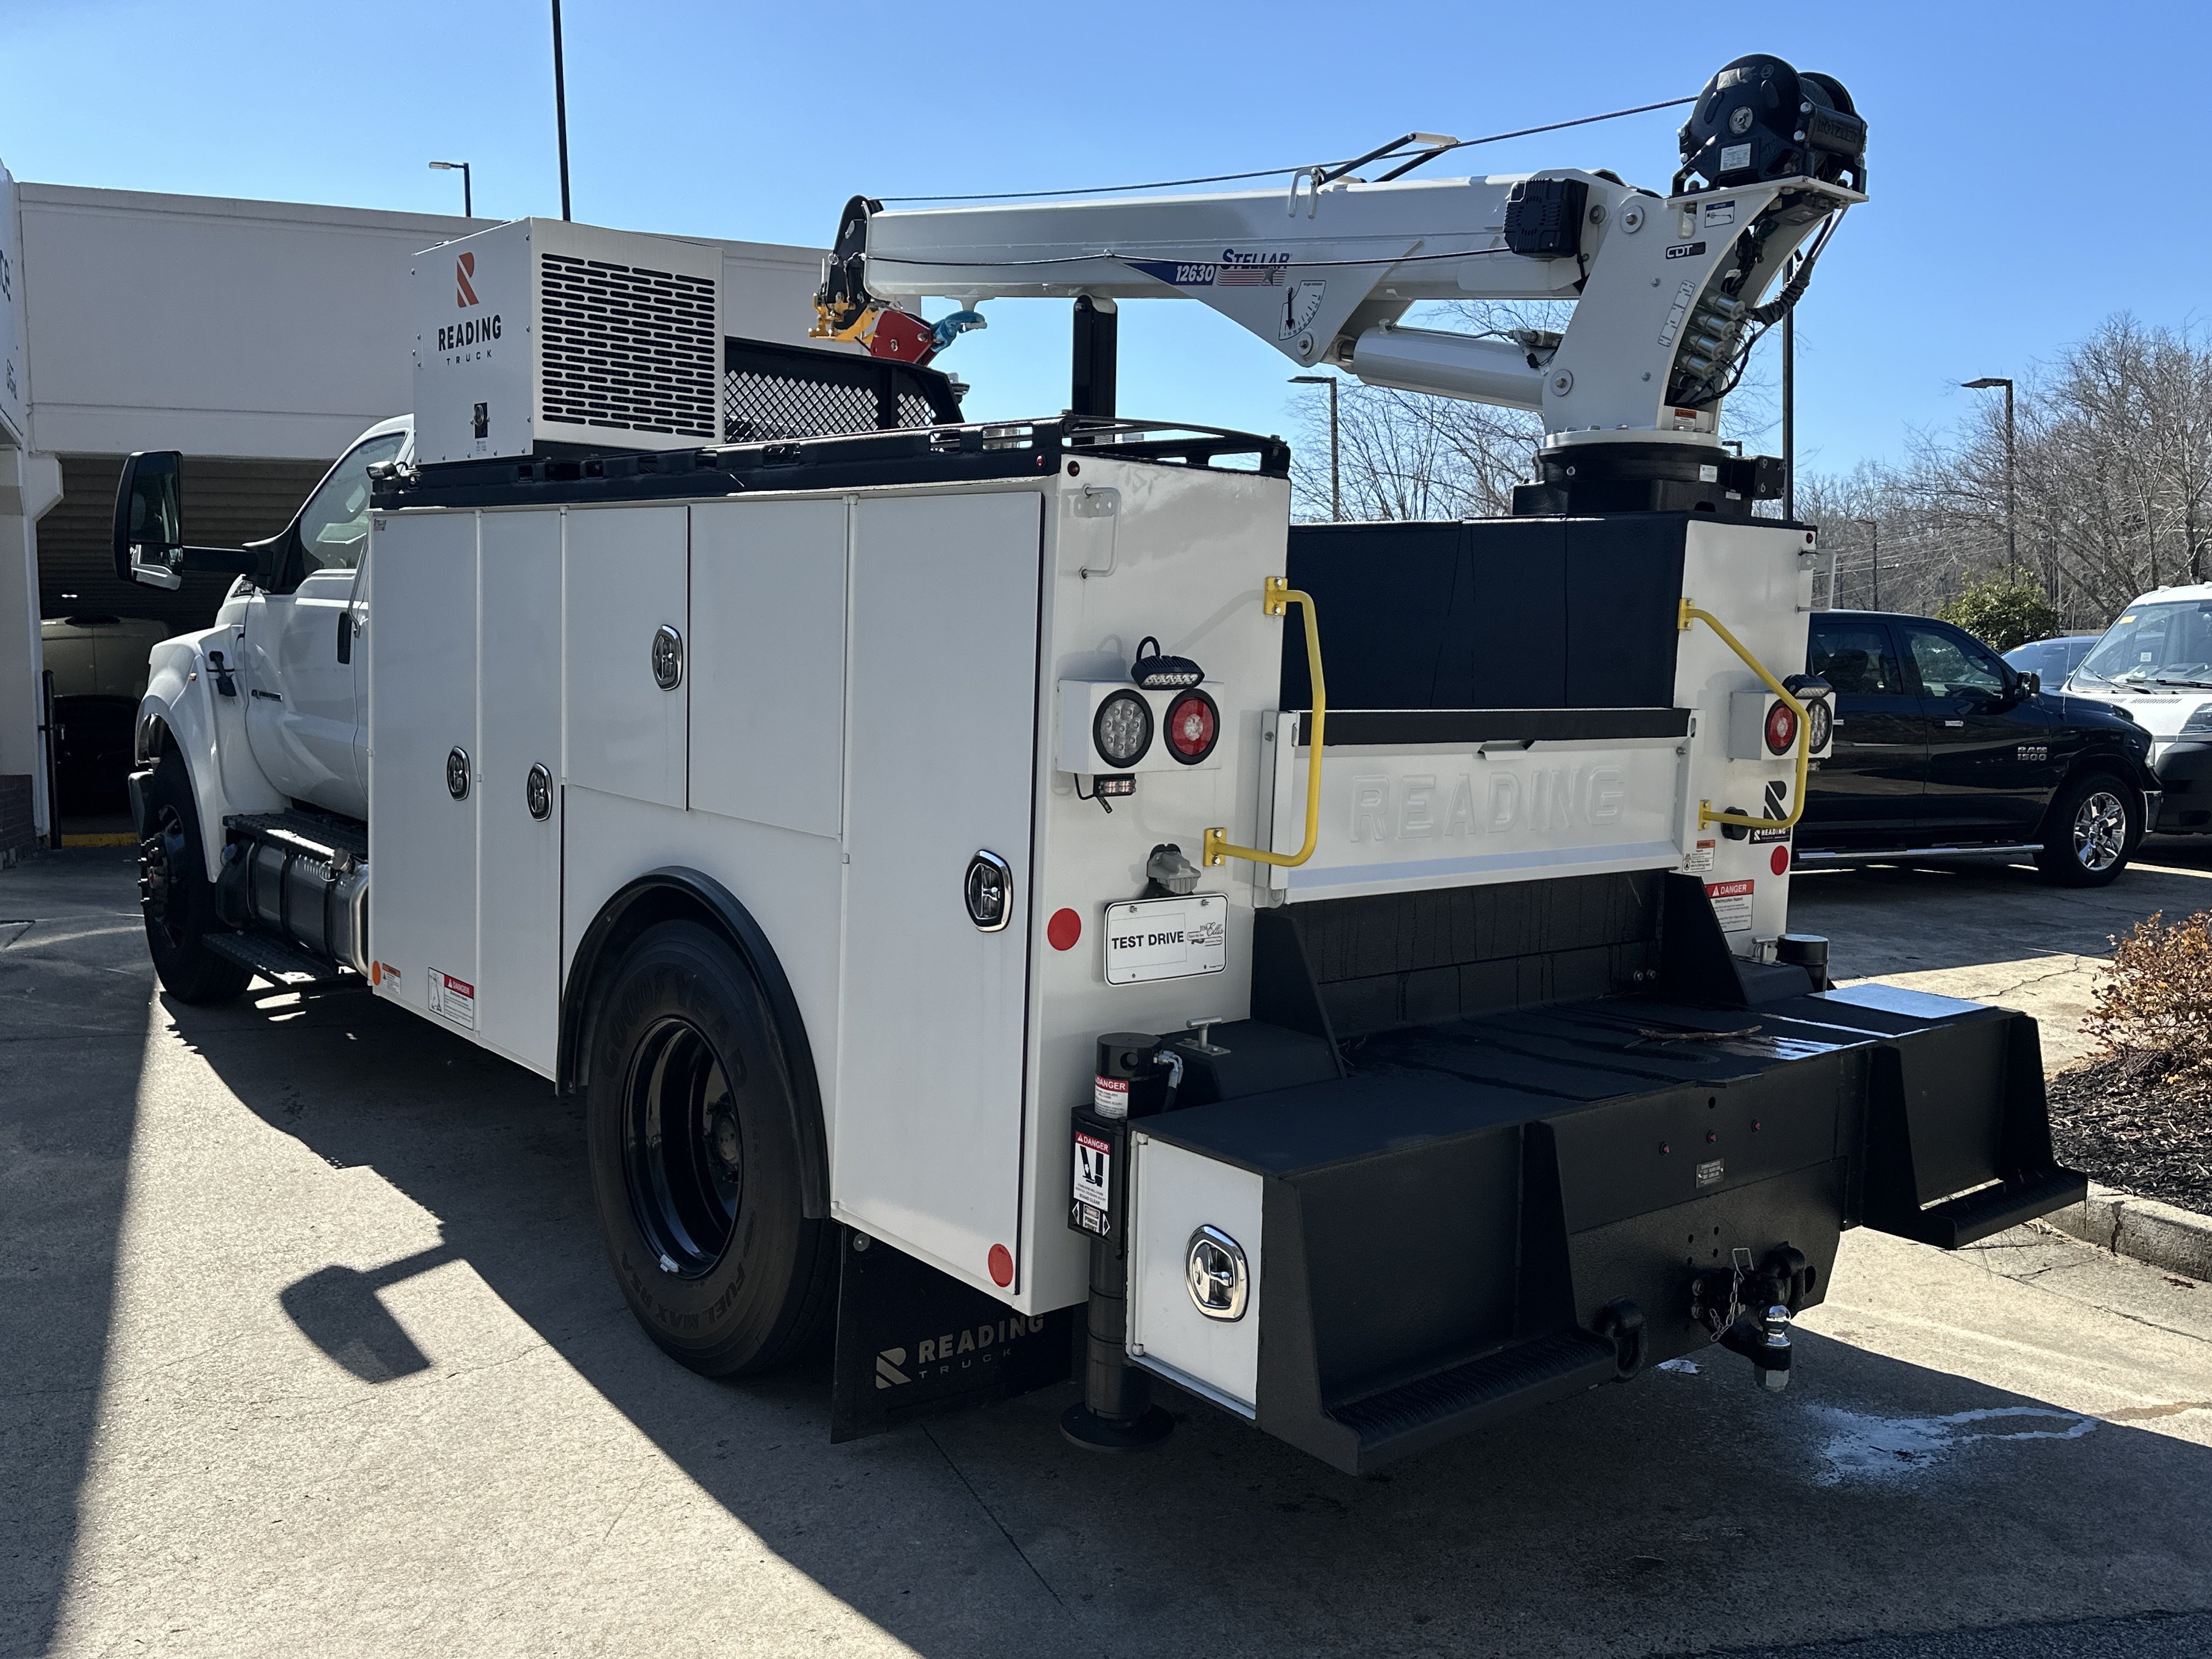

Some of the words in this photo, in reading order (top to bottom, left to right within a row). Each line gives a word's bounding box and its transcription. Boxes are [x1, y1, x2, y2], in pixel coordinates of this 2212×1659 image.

[1222, 249, 1290, 269] STELLAR
[1667, 245, 1693, 258] CDT
[1176, 265, 1215, 282] 12630
[438, 314, 501, 351] READING
[447, 349, 492, 365] TRUCK
[1350, 765, 1624, 842] READING
[1720, 884, 1747, 895] DANGER
[1111, 935, 1144, 950] TEST
[1148, 931, 1184, 946] DRIVE
[1096, 1076, 1126, 1091] DANGER
[1083, 1136, 1109, 1152] DANGER
[918, 1315, 1044, 1364] READING
[919, 1348, 1012, 1379] TRUCK
